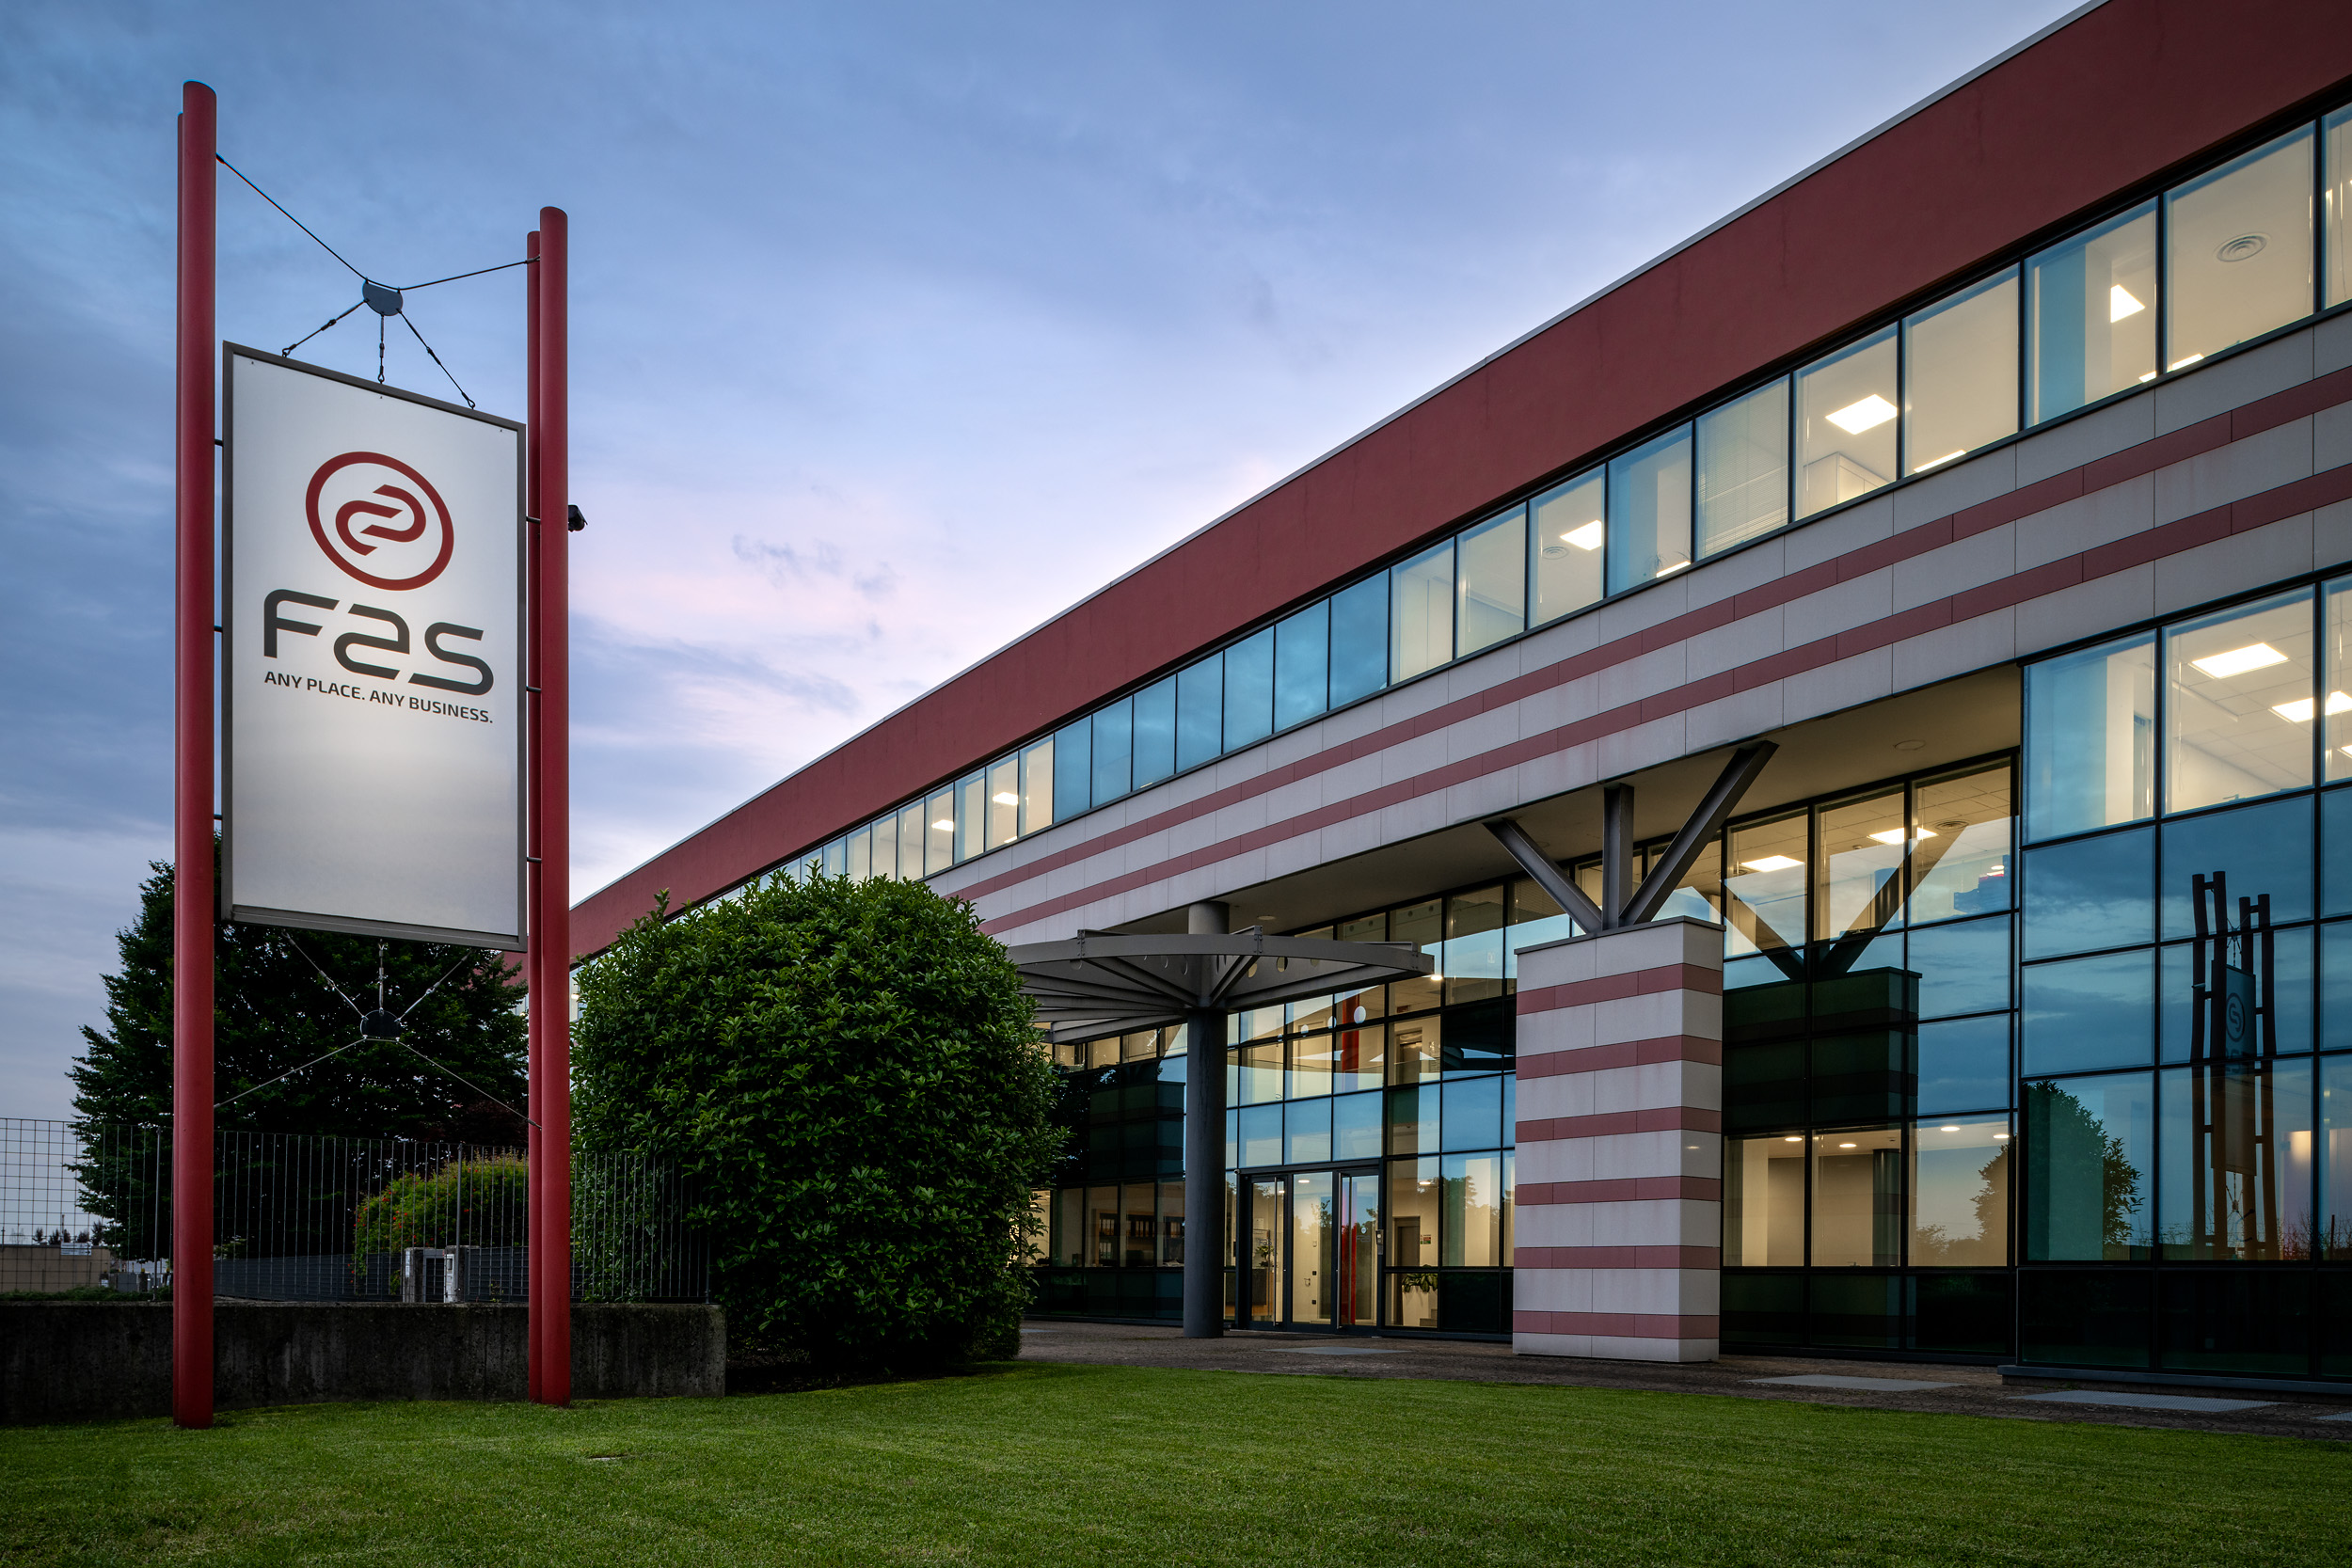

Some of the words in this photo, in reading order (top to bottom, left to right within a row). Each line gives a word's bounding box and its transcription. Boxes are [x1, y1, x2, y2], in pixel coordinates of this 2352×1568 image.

[263, 671, 302, 689] ANY
[307, 677, 365, 701] PLACE.
[369, 689, 405, 706] ANY
[409, 696, 493, 724] BUSINESS.
